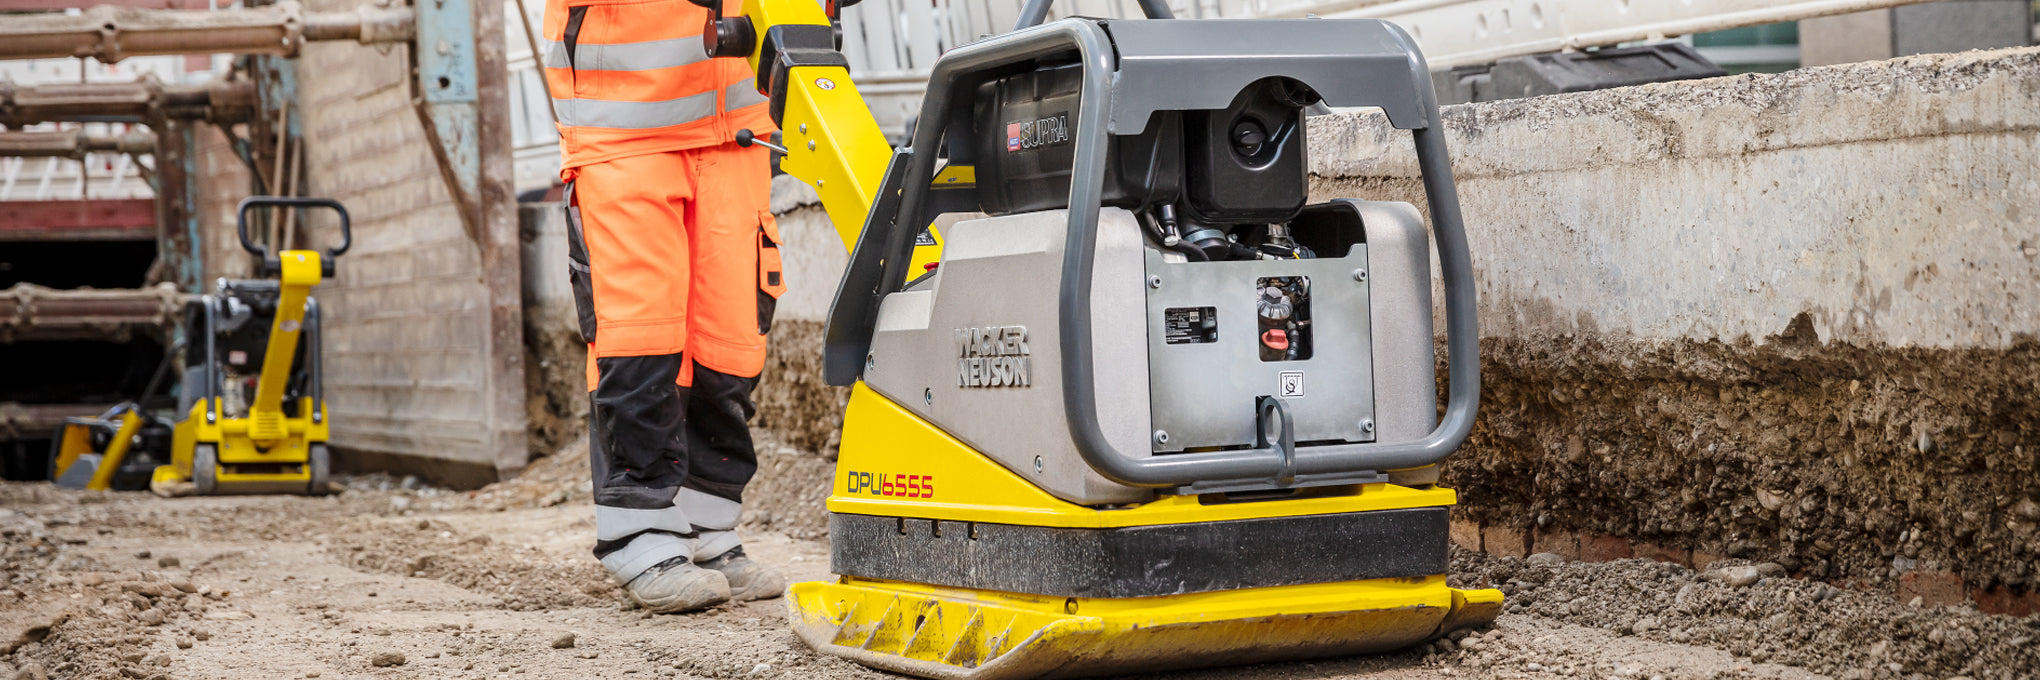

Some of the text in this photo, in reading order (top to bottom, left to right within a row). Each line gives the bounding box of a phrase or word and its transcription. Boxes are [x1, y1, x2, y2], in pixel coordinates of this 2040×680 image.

[1021, 116, 1068, 148] SUPRA
[954, 325, 1029, 357] WACKER
[957, 356, 1031, 388] NEUSON
[848, 471, 933, 498] DPU6555
